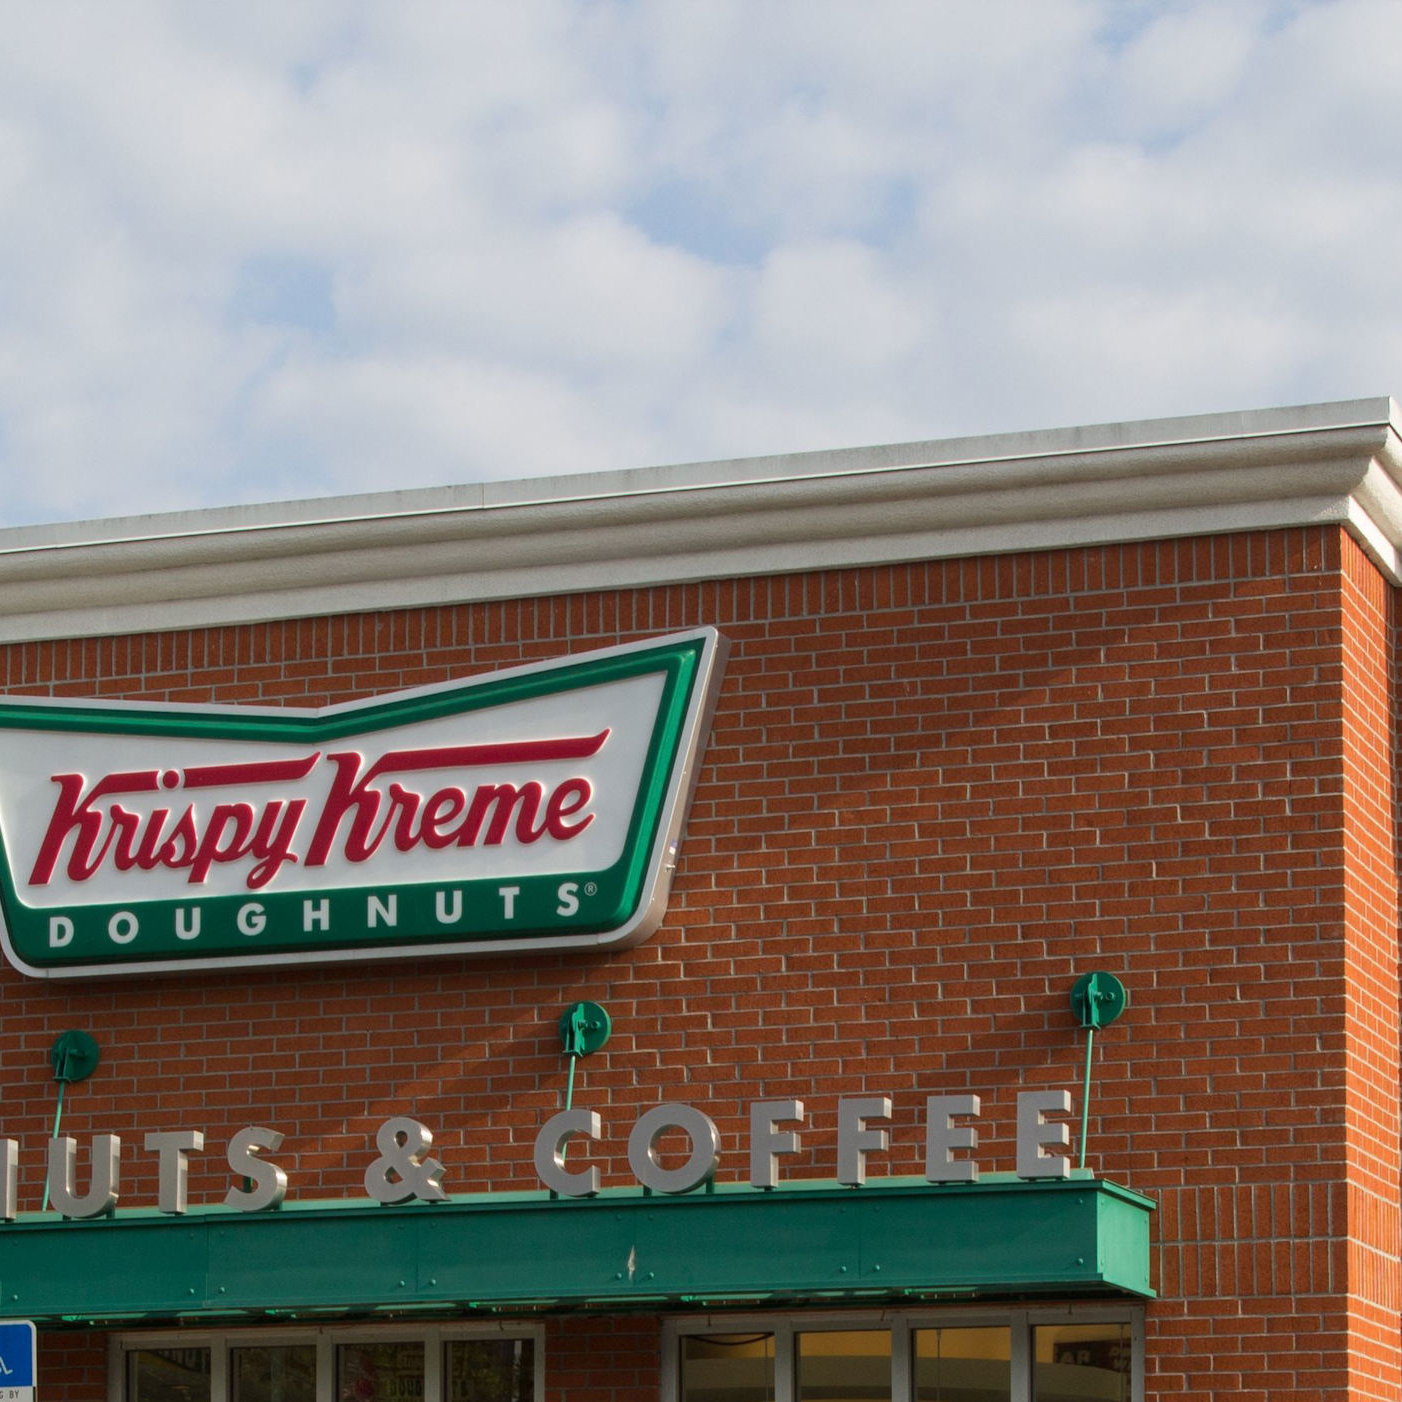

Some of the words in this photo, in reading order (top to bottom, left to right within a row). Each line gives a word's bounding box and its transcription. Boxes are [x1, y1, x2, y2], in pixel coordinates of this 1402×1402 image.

[28, 750, 321, 889] Krispy
[304, 727, 611, 866] Kreme
[364, 1116, 450, 1205] &
[534, 1088, 1072, 1198] COFFEE
[9, 1389, 20, 1399] BY
